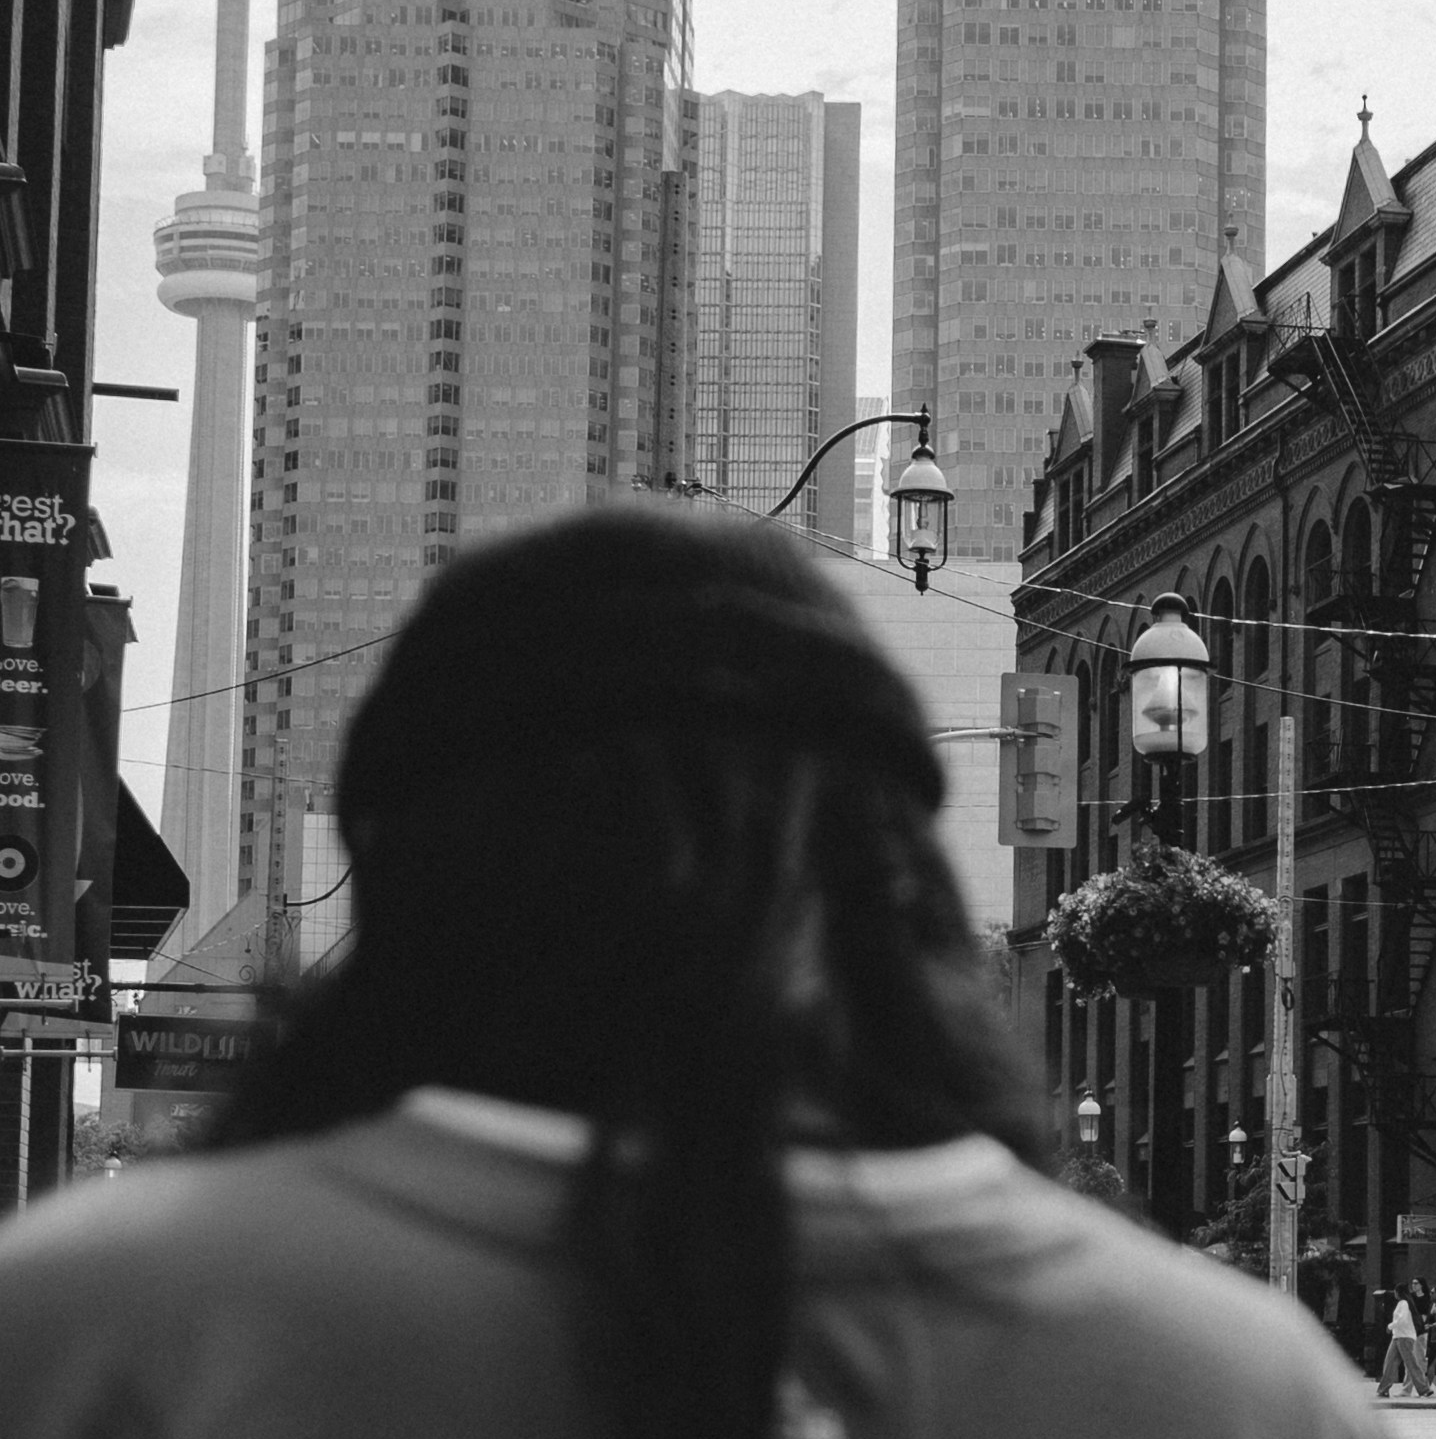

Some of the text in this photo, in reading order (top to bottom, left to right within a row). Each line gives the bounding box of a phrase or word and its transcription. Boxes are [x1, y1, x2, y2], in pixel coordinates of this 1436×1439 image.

[0, 494, 64, 519] 'est
[0, 512, 77, 546] hat?
[0, 658, 44, 673] ove.
[0, 679, 49, 694] eer.
[0, 772, 40, 786] ove.
[0, 791, 46, 808] ood.
